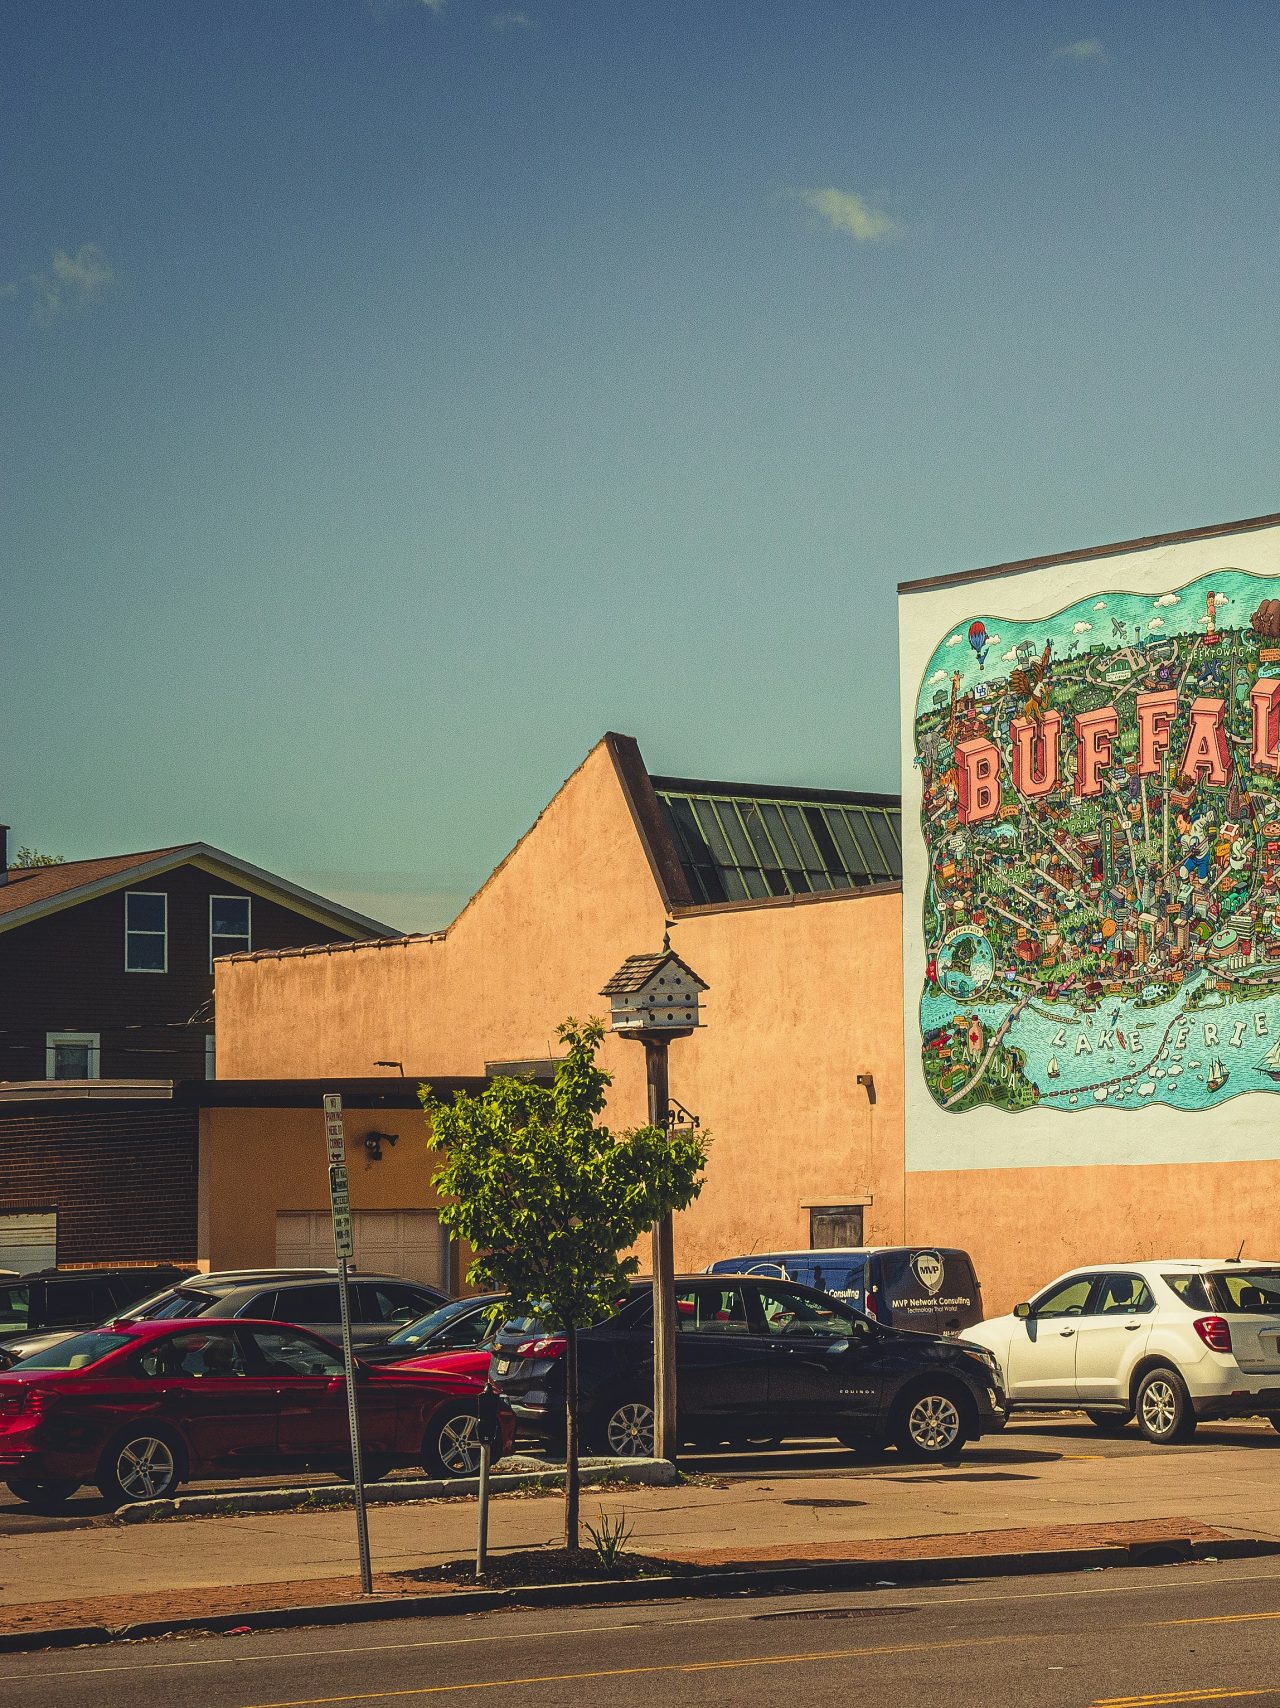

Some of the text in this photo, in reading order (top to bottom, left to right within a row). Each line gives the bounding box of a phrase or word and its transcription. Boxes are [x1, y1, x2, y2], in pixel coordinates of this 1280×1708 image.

[1181, 646, 1254, 663] CHEEKTOWAGA
[1120, 732, 1138, 741] PINE
[1121, 740, 1137, 748] HILL
[1254, 776, 1274, 787] SLOAN
[1061, 806, 1101, 826] MASTEN
[1071, 819, 1096, 831] PARK
[1104, 822, 1113, 889] BUFFALO
[987, 864, 1025, 886] ELMWOOD
[1059, 911, 1101, 930] ALLENTOWN
[930, 1010, 957, 1023] NIAGARA
[977, 1007, 996, 1015] RIVER
[1051, 1012, 1269, 1056] LAKE ERIE
[950, 1047, 1017, 1091] CANADA
[919, 1265, 940, 1276] MVP
[828, 1288, 860, 1300] Consulting
[892, 1296, 971, 1308] MVP Network Consulting
